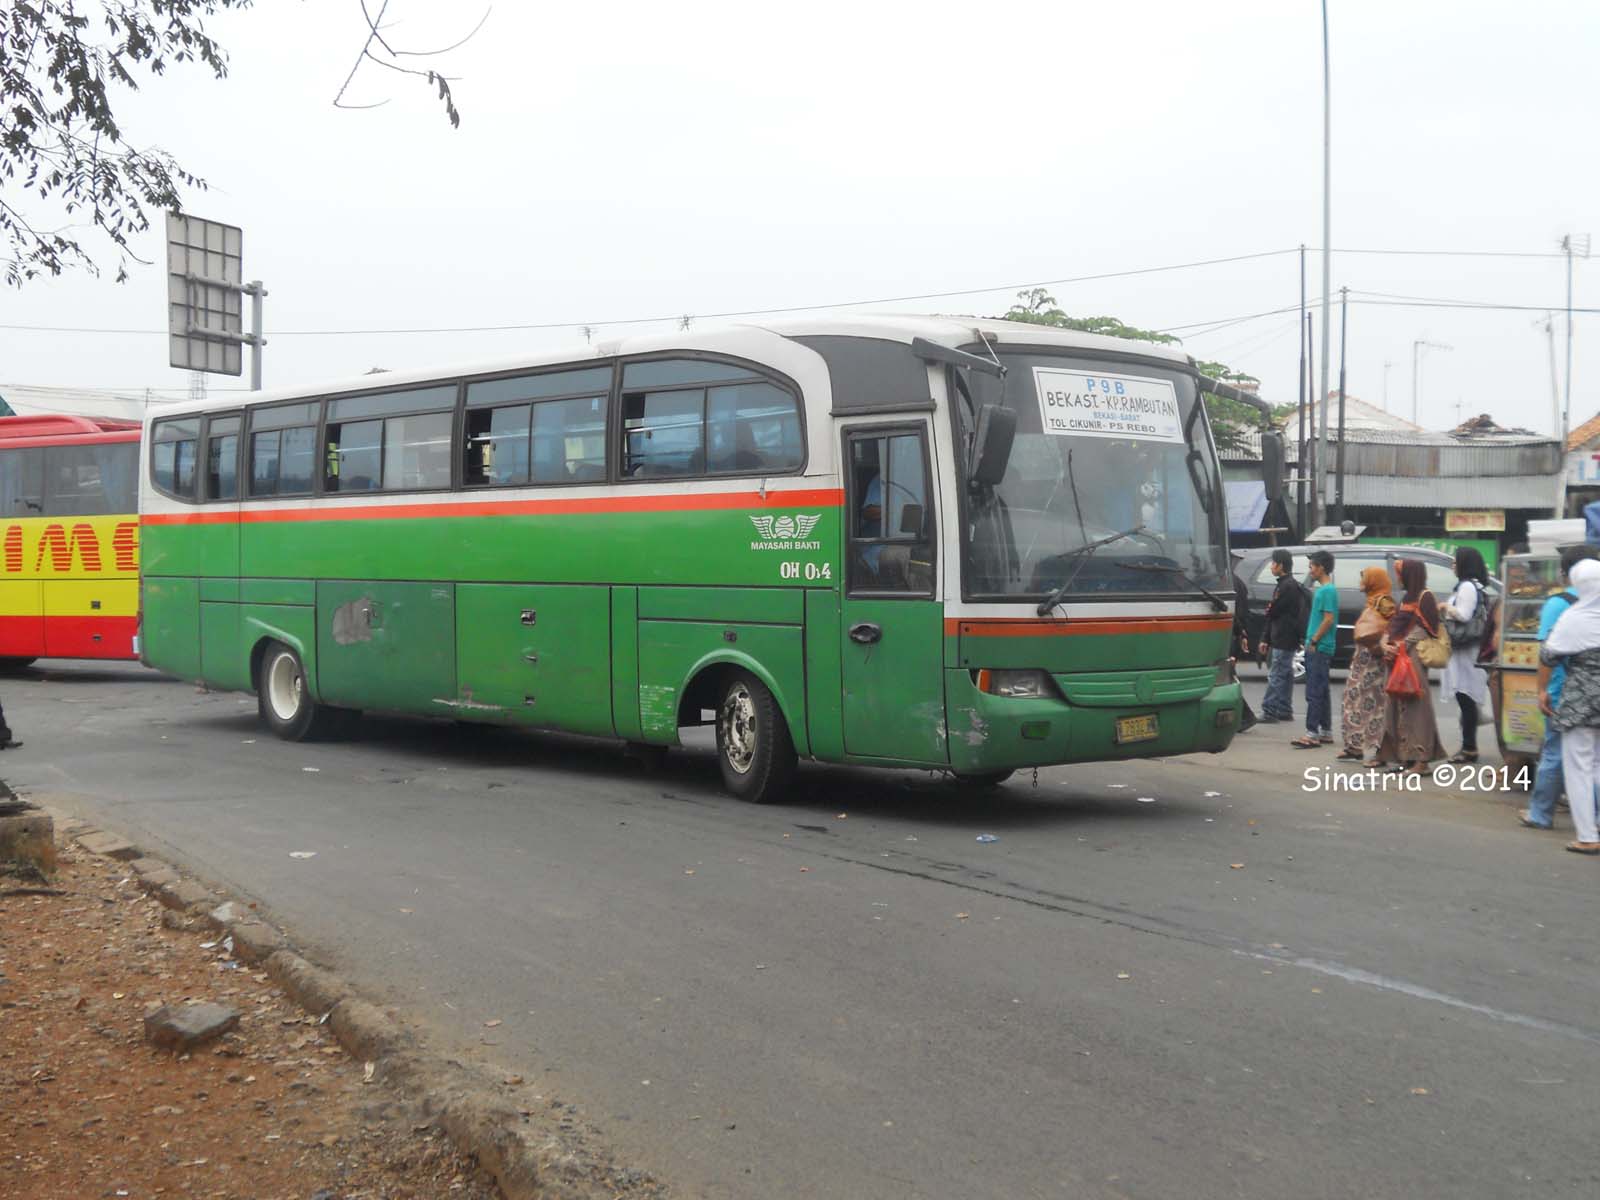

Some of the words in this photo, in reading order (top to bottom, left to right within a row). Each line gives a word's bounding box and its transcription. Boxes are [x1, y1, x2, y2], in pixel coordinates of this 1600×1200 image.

[1049, 418, 1066, 428] TOL
[1127, 423, 1156, 433] REBO
[751, 542, 793, 550] MAYASARI
[795, 541, 820, 550] BAKTI
